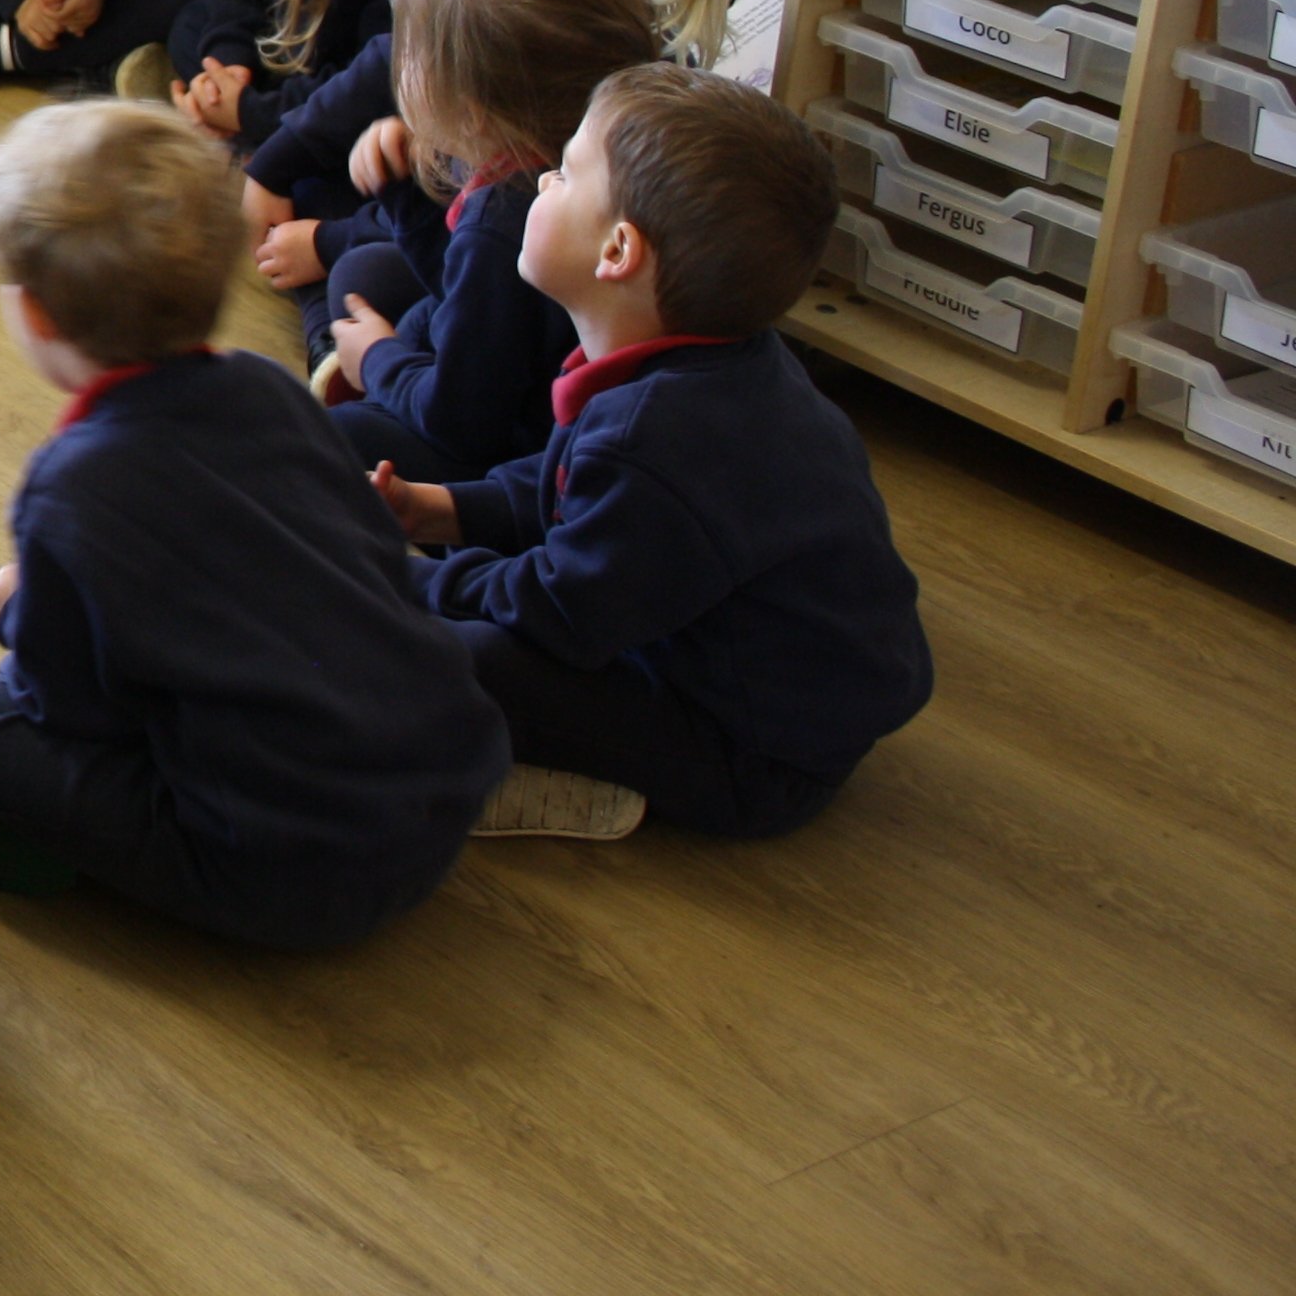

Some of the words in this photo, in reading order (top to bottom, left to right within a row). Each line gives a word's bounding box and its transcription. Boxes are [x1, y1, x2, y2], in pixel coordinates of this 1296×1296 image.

[959, 16, 1011, 45] Coco
[943, 109, 991, 144] Elsie
[918, 192, 986, 236] Fergus
